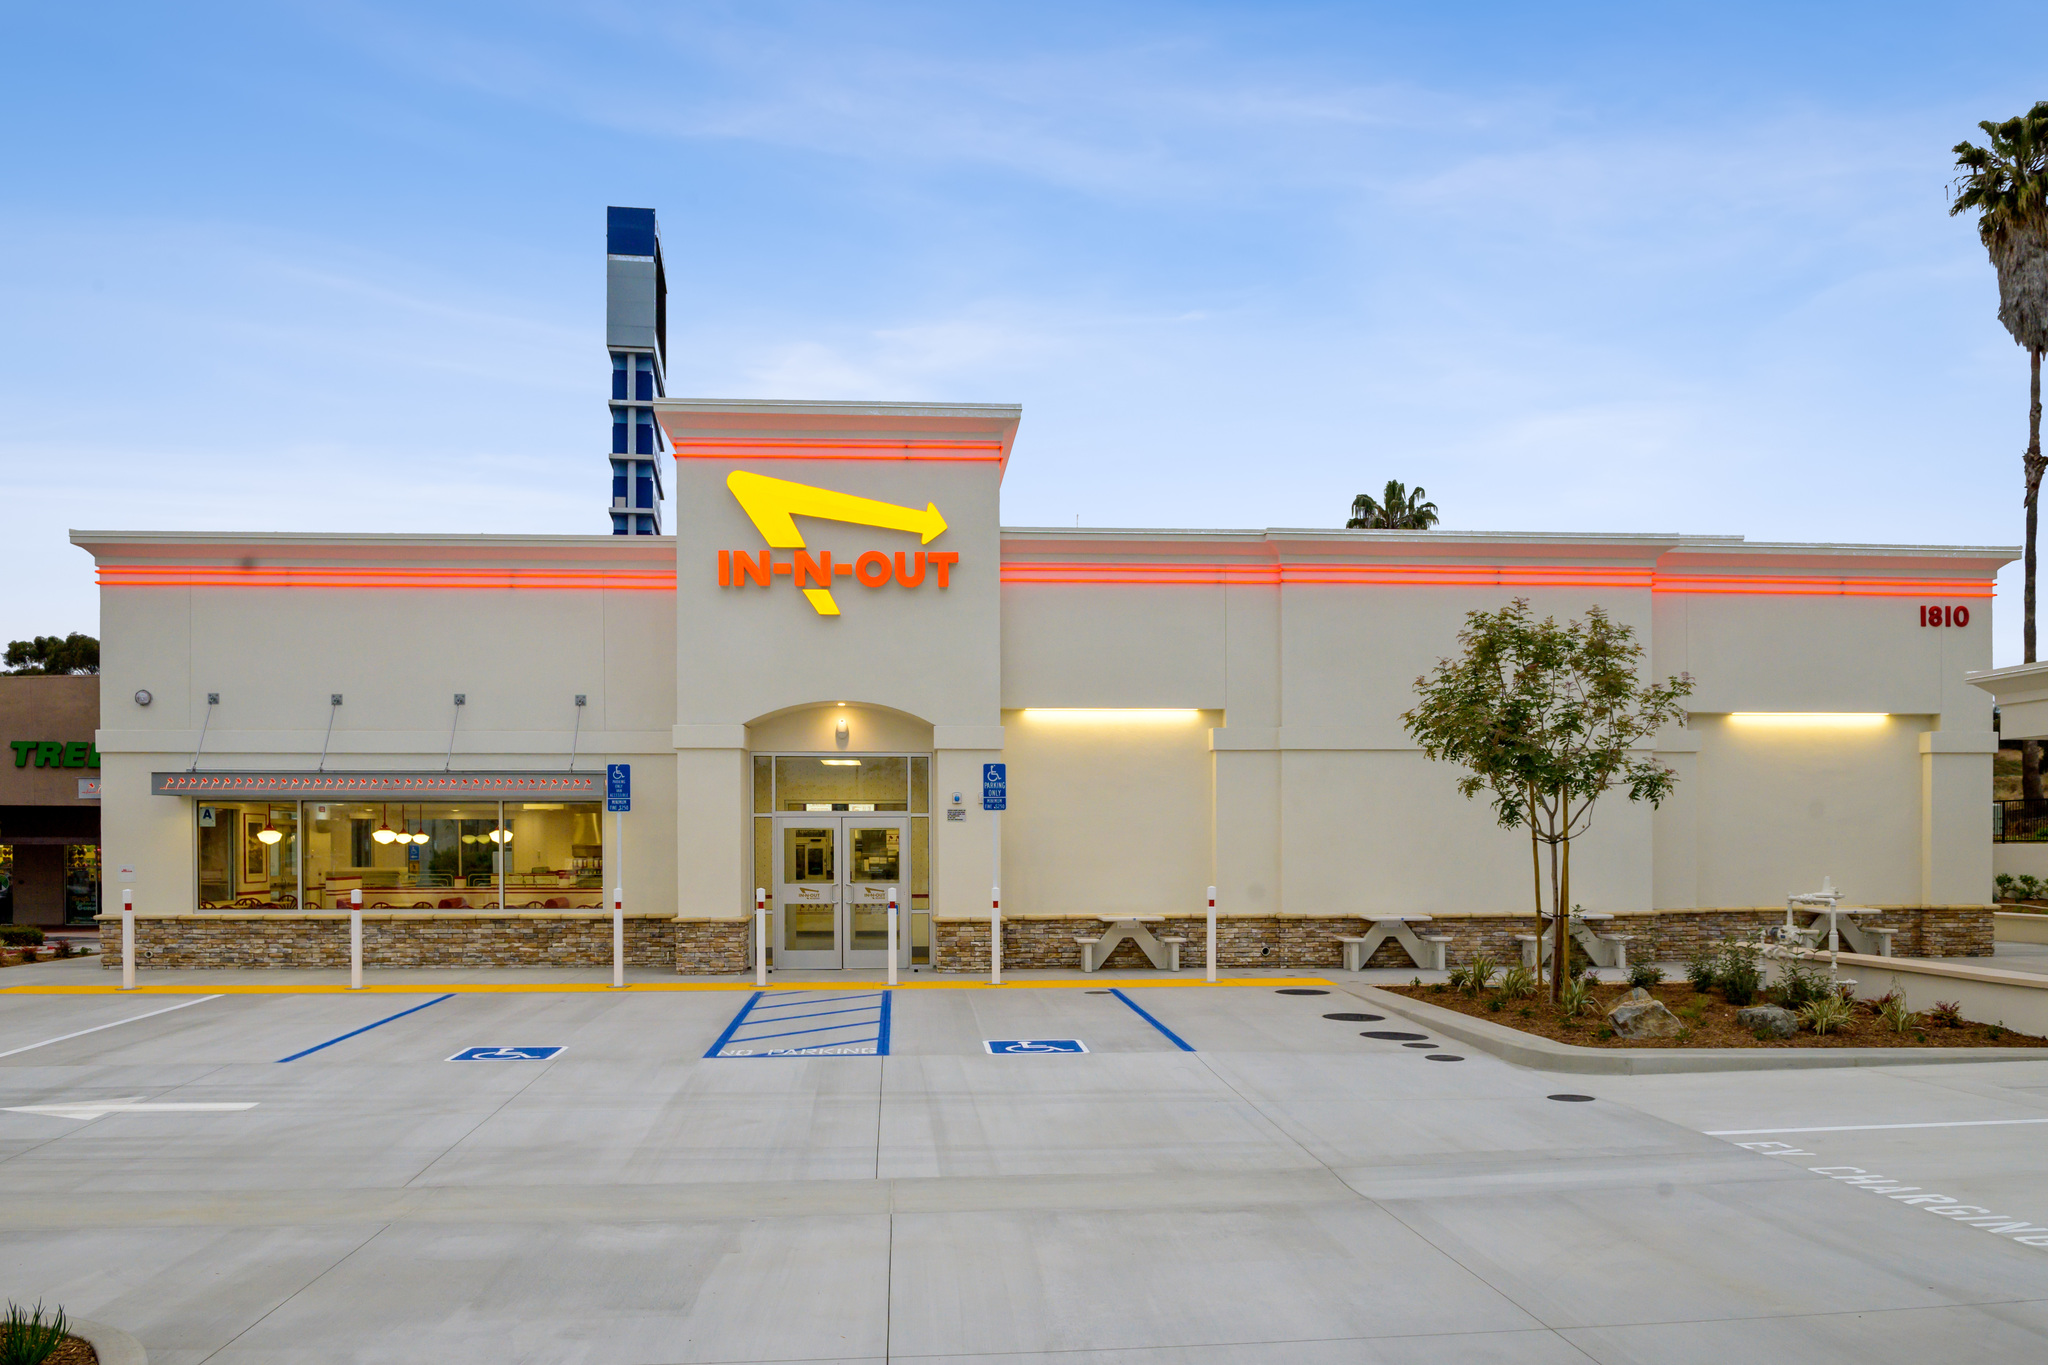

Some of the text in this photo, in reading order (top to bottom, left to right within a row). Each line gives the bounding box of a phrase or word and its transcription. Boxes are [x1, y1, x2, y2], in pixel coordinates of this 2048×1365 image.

[718, 550, 959, 588] IN-N-OUT
[1920, 605, 1970, 628] 1810
[202, 809, 212, 819] A
[716, 1047, 877, 1057] NO PARKING
[1734, 1141, 1816, 1156] EV
